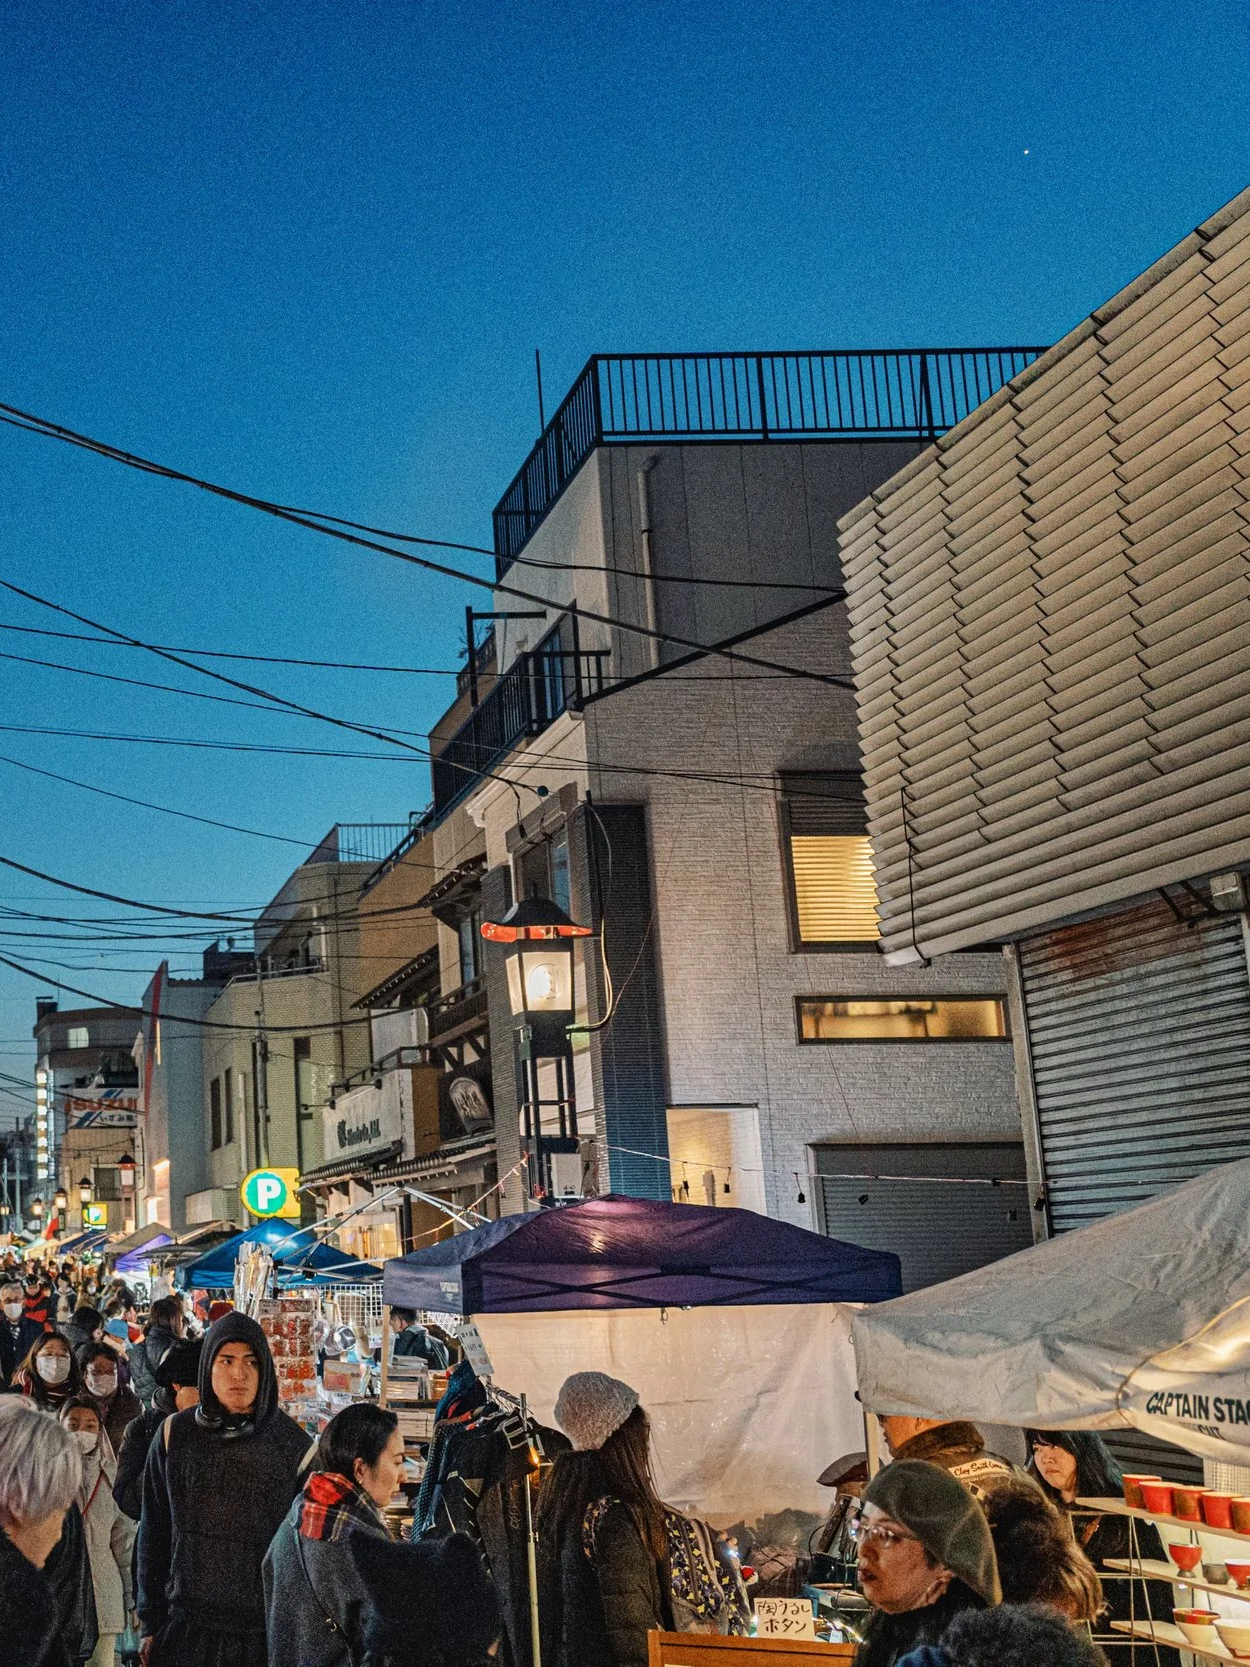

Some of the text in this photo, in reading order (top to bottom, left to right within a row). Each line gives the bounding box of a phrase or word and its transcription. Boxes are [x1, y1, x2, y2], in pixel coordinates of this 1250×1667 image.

[257, 1178, 281, 1210] P
[1146, 1391, 1250, 1425] CAPTAIN STA
